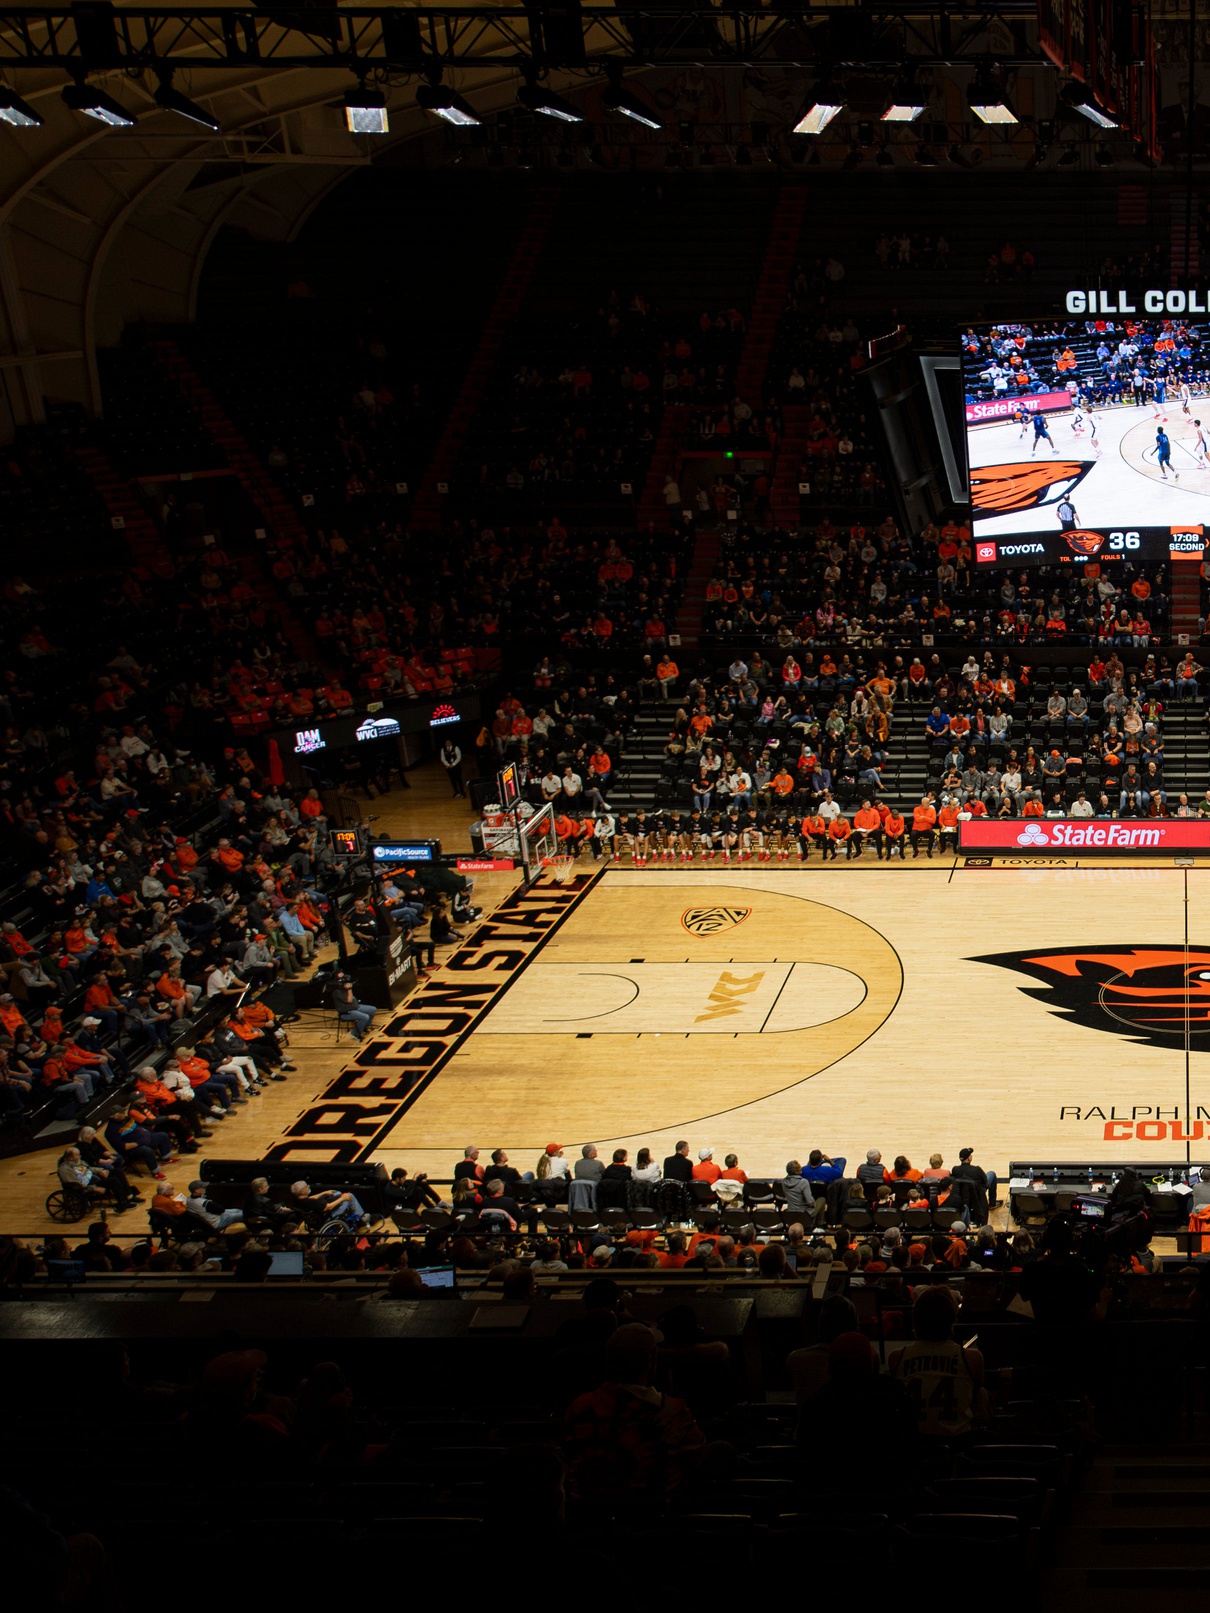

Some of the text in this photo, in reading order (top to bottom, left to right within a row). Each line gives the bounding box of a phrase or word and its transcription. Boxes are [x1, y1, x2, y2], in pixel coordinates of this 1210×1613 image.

[1066, 290, 1136, 314] GILL
[1109, 532, 1140, 550] 36
[1172, 534, 1199, 542] 17:09
[999, 543, 1045, 556] TOYOTA
[1169, 543, 1205, 551] SECOND
[429, 715, 461, 727] BELIEVERS
[296, 728, 321, 747] DAM
[355, 728, 378, 742] WVCI
[337, 832, 355, 841] 17:09
[347, 841, 354, 851] 7
[385, 847, 429, 857] PacificSource
[388, 955, 412, 987] BI-MART
[1059, 1106, 1179, 1121] RALPH
